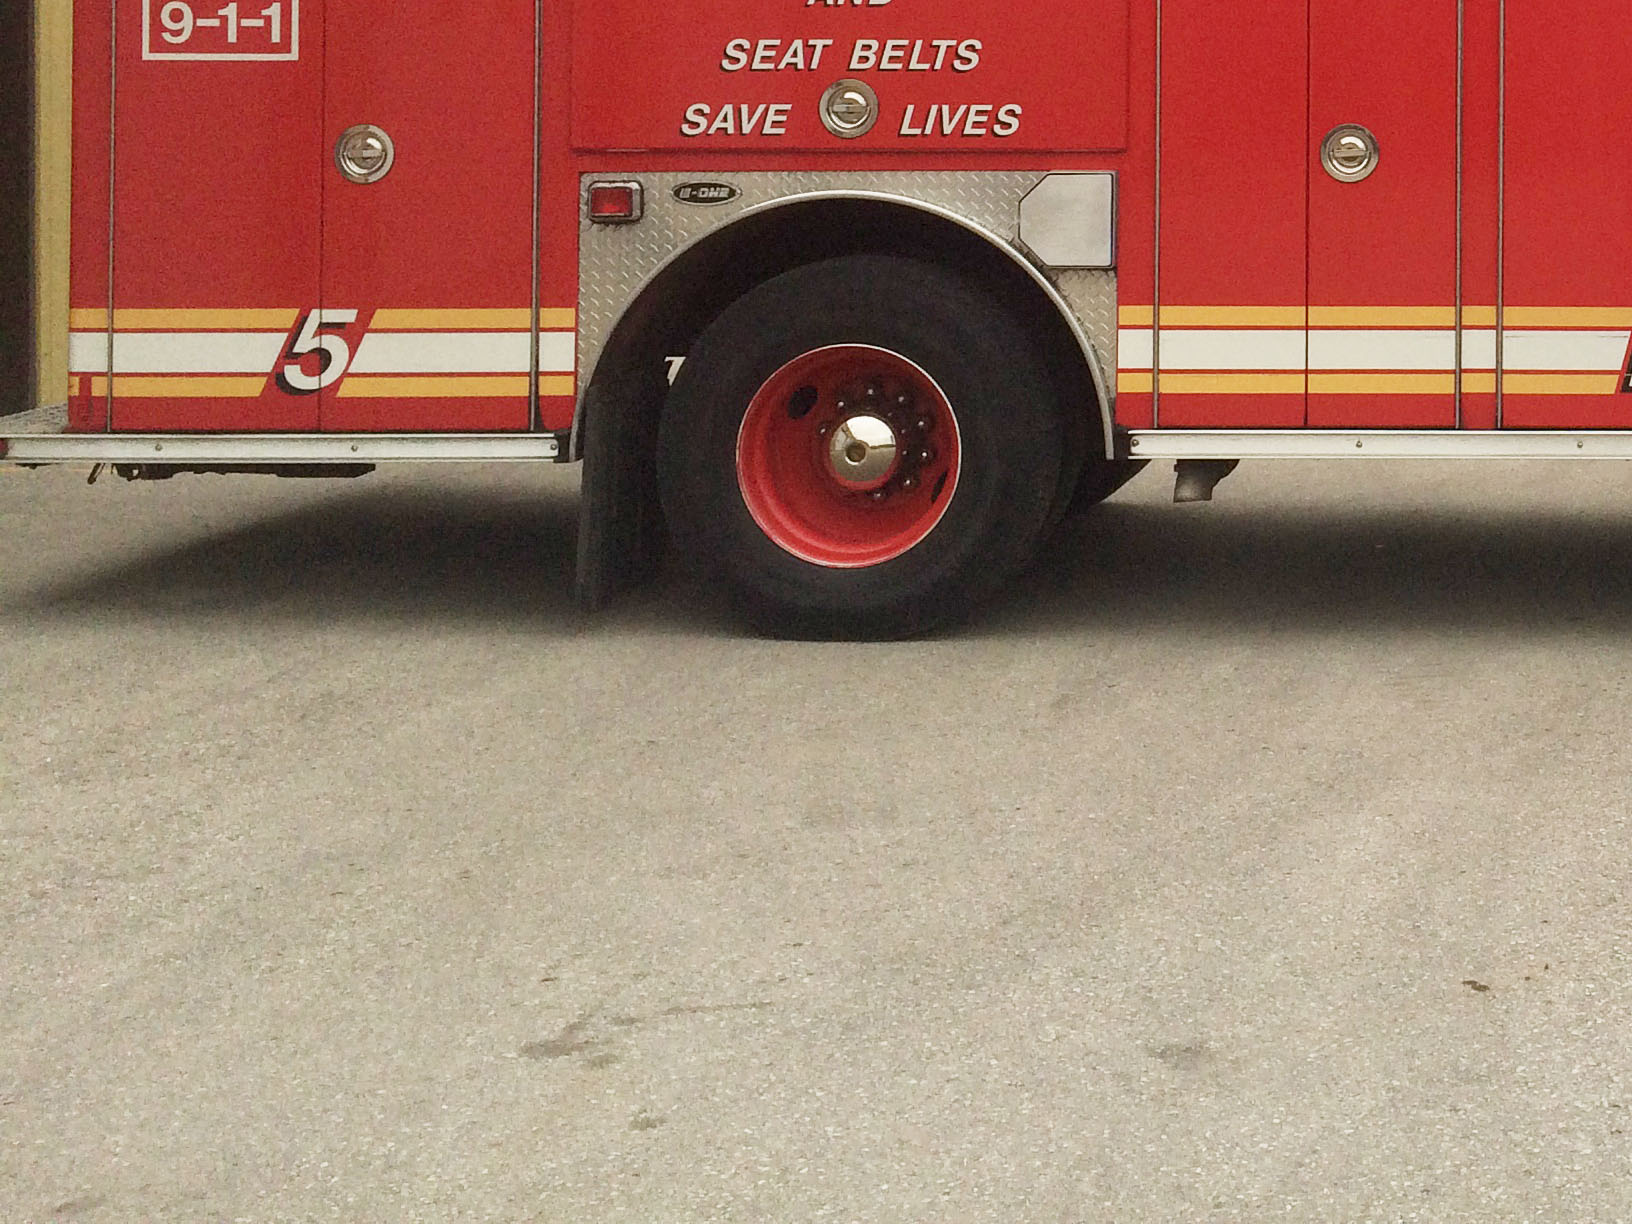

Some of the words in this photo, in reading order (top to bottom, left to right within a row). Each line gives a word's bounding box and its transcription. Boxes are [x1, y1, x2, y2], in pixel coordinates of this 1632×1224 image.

[160, 0, 281, 44] 9-1-1
[720, 39, 832, 72] SEAT
[848, 39, 982, 72] BELTS
[680, 103, 792, 137] SAVE
[899, 103, 1022, 137] LIVES
[276, 308, 358, 395] 5
